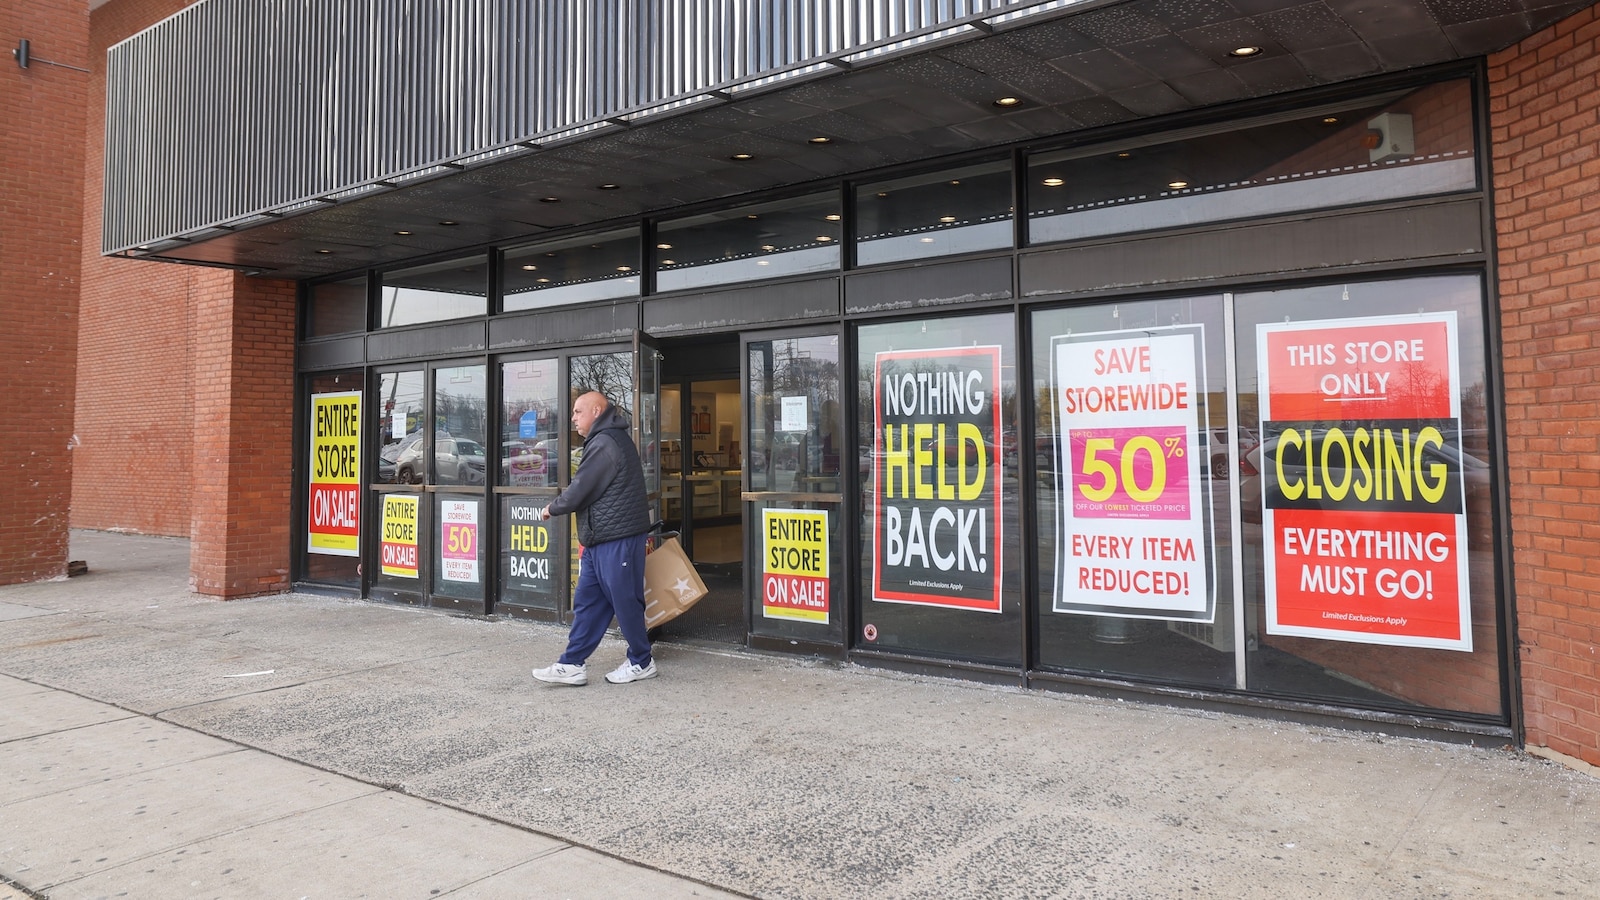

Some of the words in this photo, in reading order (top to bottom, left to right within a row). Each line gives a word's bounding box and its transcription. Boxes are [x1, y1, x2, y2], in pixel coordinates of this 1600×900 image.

[1094, 346, 1151, 376] SAVE
[1287, 344, 1336, 366] THIS
[1344, 340, 1424, 363] STORE
[885, 369, 985, 416] NOTHING
[1066, 382, 1188, 414] STOREWIDE
[1320, 372, 1390, 396] ONLY
[317, 404, 357, 438] ENTIRE
[317, 444, 356, 478] STORE
[886, 422, 987, 500] HELD
[1078, 435, 1184, 503] 50%
[1275, 426, 1448, 504] CLOSING
[314, 489, 330, 527] ON
[332, 490, 356, 528] SALE!
[386, 502, 414, 519] ENTIRE
[448, 512, 472, 520] STOREWIDE
[386, 522, 413, 540] STORE
[511, 524, 548, 552] HELD
[770, 518, 822, 542] ENTIRE
[886, 506, 987, 574] BACK!
[384, 544, 395, 564] ON
[396, 546, 416, 566] SALE!
[771, 546, 820, 571] STORE
[1072, 534, 1134, 560] EVERY
[1142, 537, 1196, 562] ITEM
[1284, 527, 1449, 563] EVERYTHING
[446, 561, 460, 570] EVERY
[462, 562, 472, 570] ITEM
[448, 570, 472, 580] REDUCED!
[510, 556, 548, 580] BACK!
[766, 576, 788, 603] ON
[791, 578, 824, 608] SALE!
[926, 581, 950, 589] Exclusions
[950, 583, 964, 592] Apply
[1078, 566, 1190, 596] REDUCED!
[1300, 565, 1368, 596] MUST
[1375, 568, 1434, 600] GO!
[1322, 611, 1348, 620] Limited
[1348, 613, 1384, 624] Exclusions
[1385, 616, 1408, 626] Apply
